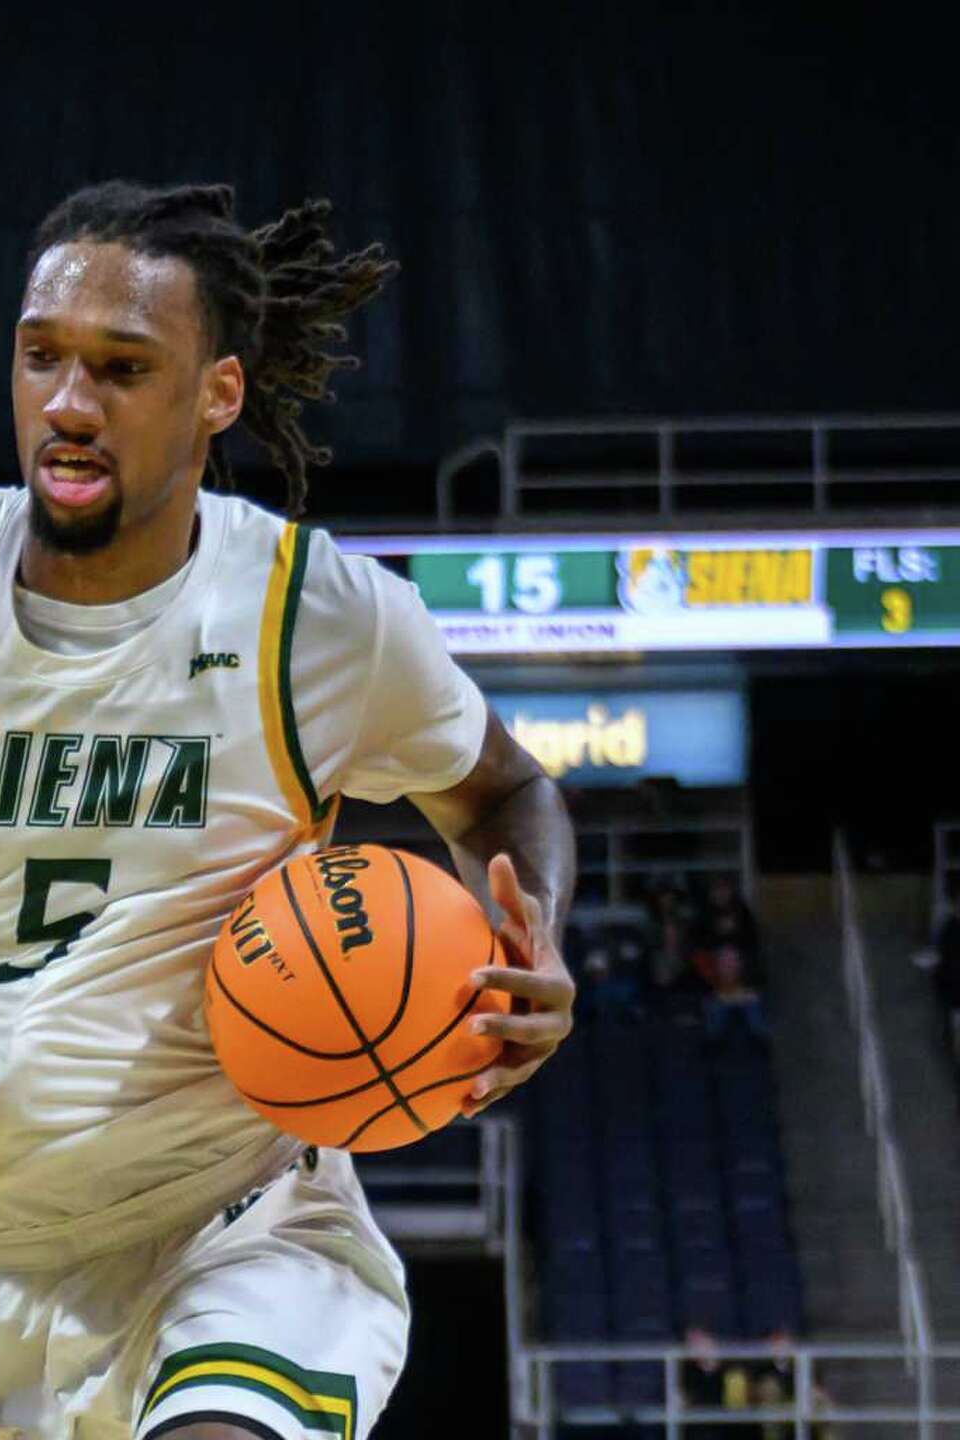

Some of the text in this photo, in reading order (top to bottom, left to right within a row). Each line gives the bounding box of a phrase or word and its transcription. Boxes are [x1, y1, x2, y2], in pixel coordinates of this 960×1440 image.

[466, 554, 562, 613] 15
[687, 549, 811, 604] SIENA
[881, 587, 912, 634] 3
[189, 652, 240, 680] MAAC
